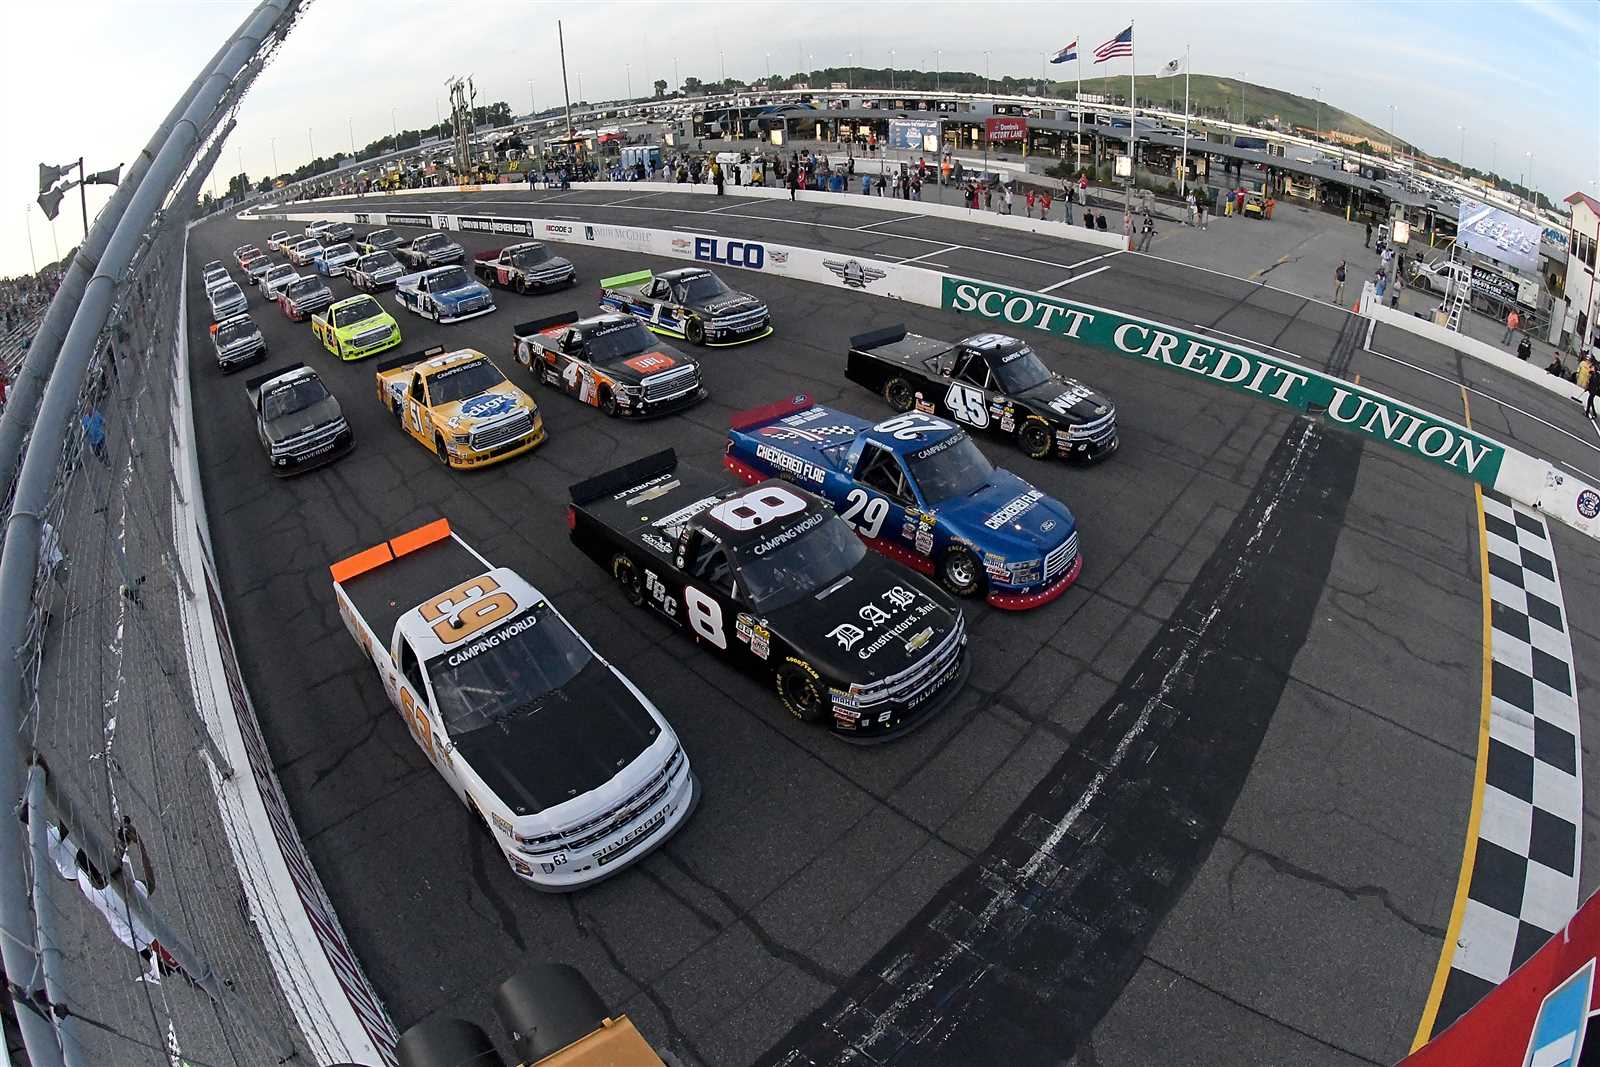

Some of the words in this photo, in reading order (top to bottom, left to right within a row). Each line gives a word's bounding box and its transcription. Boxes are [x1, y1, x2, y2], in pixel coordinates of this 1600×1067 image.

[550, 224, 567, 233] CODE
[695, 236, 764, 269] ELCO
[596, 327, 620, 336] CAMPING
[620, 322, 638, 331] WORLD
[651, 303, 663, 324] 1
[532, 342, 545, 357] JBL
[636, 357, 664, 370] JBL
[1002, 352, 1020, 364] CAMPING
[437, 368, 462, 379] CAMPING
[463, 361, 482, 371] WORLD
[952, 284, 1095, 338] SCOTT
[1114, 323, 1309, 402] CREDIT
[1326, 387, 1492, 474] UNION
[945, 384, 988, 428] 45
[918, 442, 947, 460] CAMPING
[946, 433, 964, 449] WORLD
[756, 444, 804, 478] CHECKERED
[804, 463, 826, 484] FLAG
[614, 474, 672, 500] CHEVROLET
[709, 486, 808, 531] 8
[840, 488, 890, 539] 29
[754, 528, 797, 556] CAMPING
[796, 514, 823, 535] WORLD
[644, 568, 678, 617] TBC
[418, 576, 518, 644] 63
[686, 586, 727, 650] 8
[448, 635, 500, 666] CAMPING
[498, 616, 537, 642] WORLD
[786, 655, 820, 680] GOODYEAR
[908, 661, 960, 710] SILVERADO
[878, 711, 892, 722] 8
[592, 804, 671, 857] SILVERADO
[553, 853, 568, 866] 63
